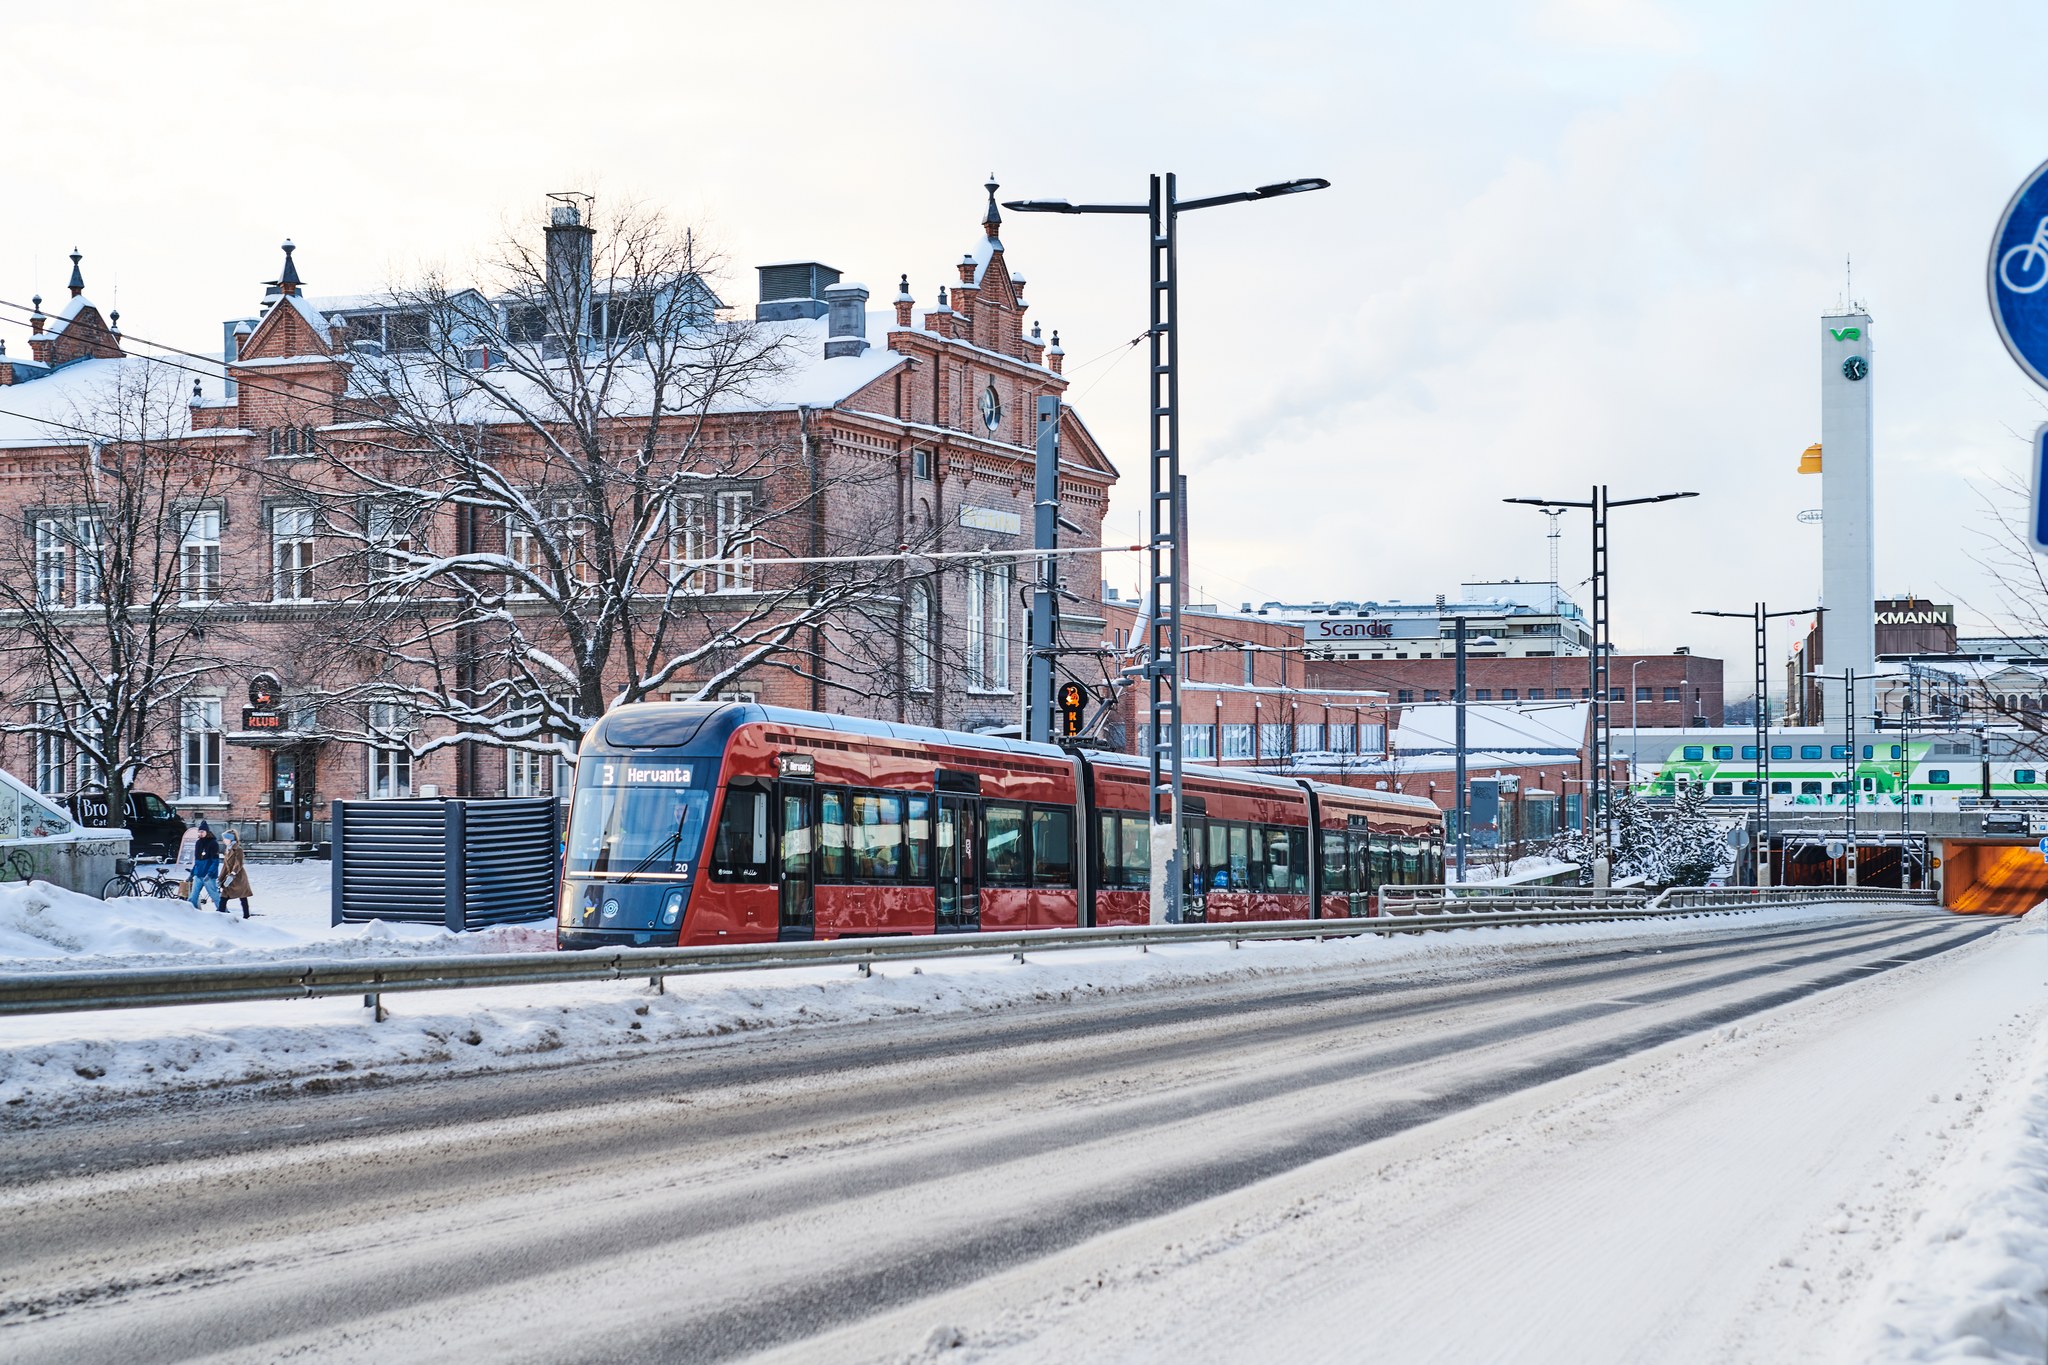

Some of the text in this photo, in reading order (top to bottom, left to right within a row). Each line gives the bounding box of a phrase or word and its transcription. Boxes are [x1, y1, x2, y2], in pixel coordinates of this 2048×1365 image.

[1830, 327, 1861, 342] VR
[1320, 619, 1393, 637] Scandic
[248, 716, 279, 727] KLUBI
[781, 758, 787, 772] 3
[602, 765, 691, 786] 3 Hervanta
[82, 799, 131, 817] Broo
[675, 863, 688, 873] 20
